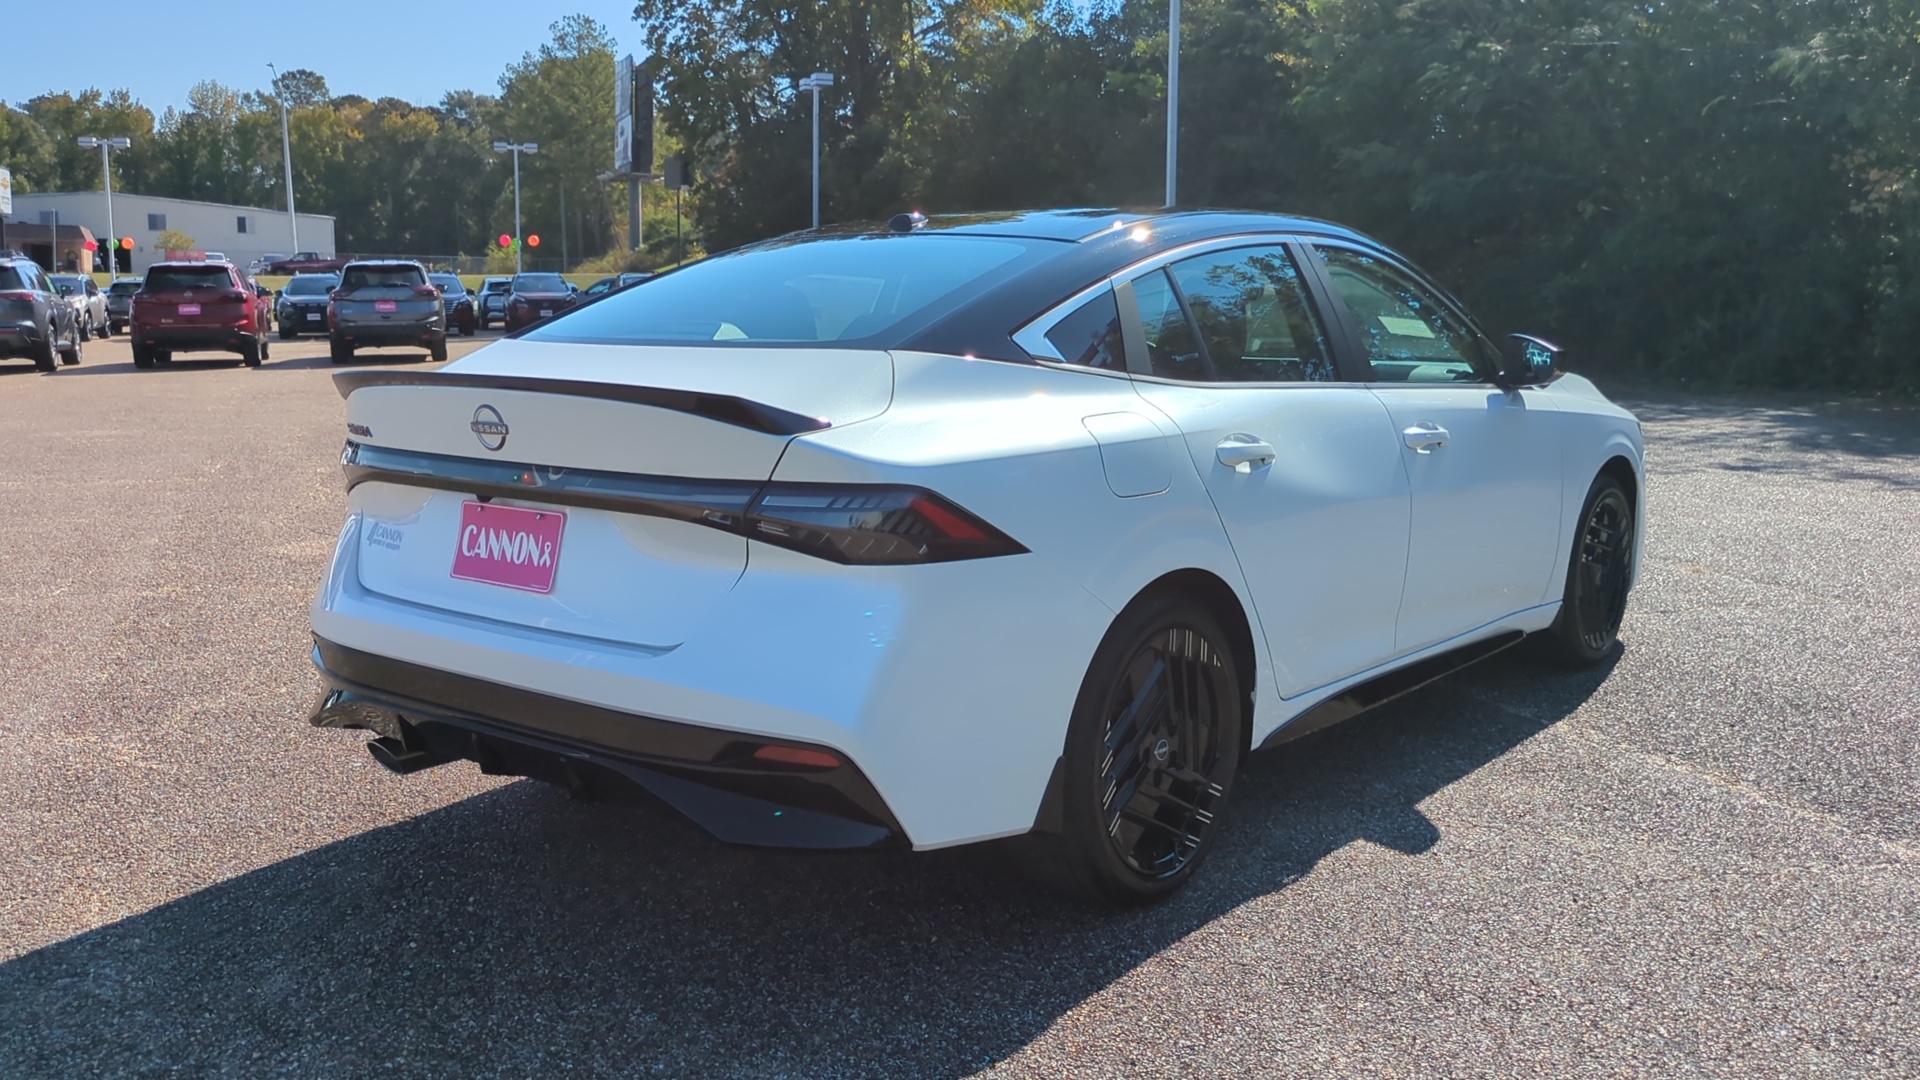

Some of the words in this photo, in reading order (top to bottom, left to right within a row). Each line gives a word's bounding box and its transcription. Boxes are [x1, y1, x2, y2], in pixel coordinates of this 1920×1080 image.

[471, 423, 506, 434] NISSAN
[376, 525, 404, 544] CANNON
[462, 524, 543, 568] CANNON
